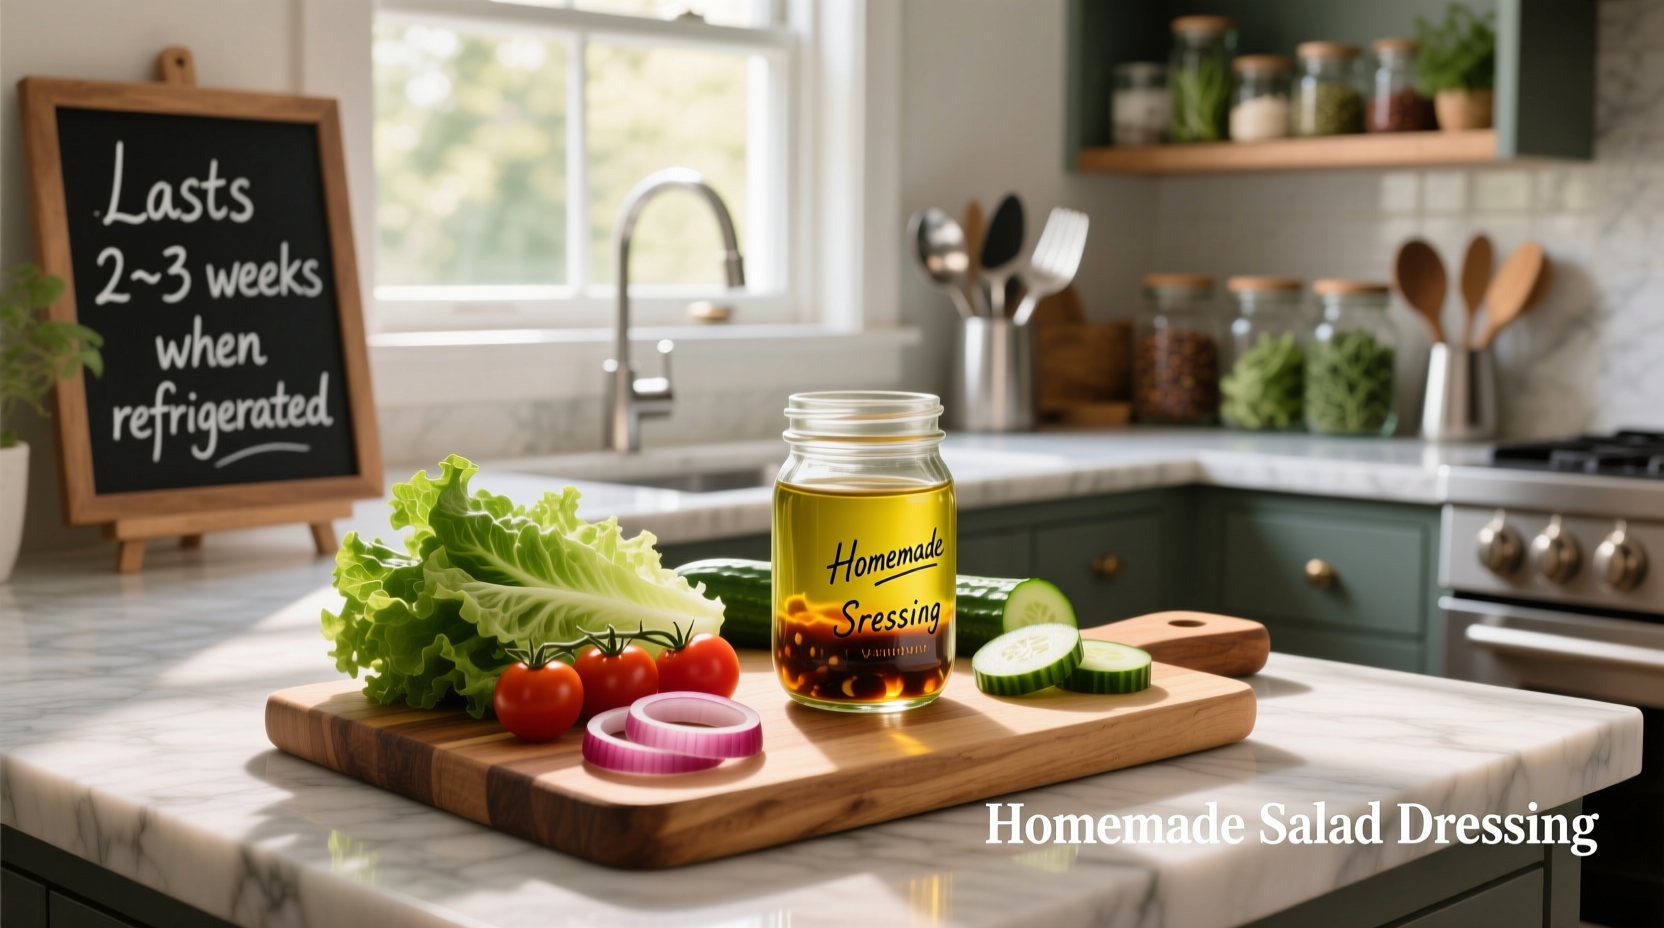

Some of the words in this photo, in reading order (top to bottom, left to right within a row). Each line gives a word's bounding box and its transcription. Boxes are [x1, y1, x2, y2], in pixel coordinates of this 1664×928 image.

[102, 140, 254, 226] Lasts
[205, 241, 323, 299] weeks
[155, 314, 268, 370] when
[112, 371, 334, 463] refrigerated
[827, 527, 944, 585] Homemade
